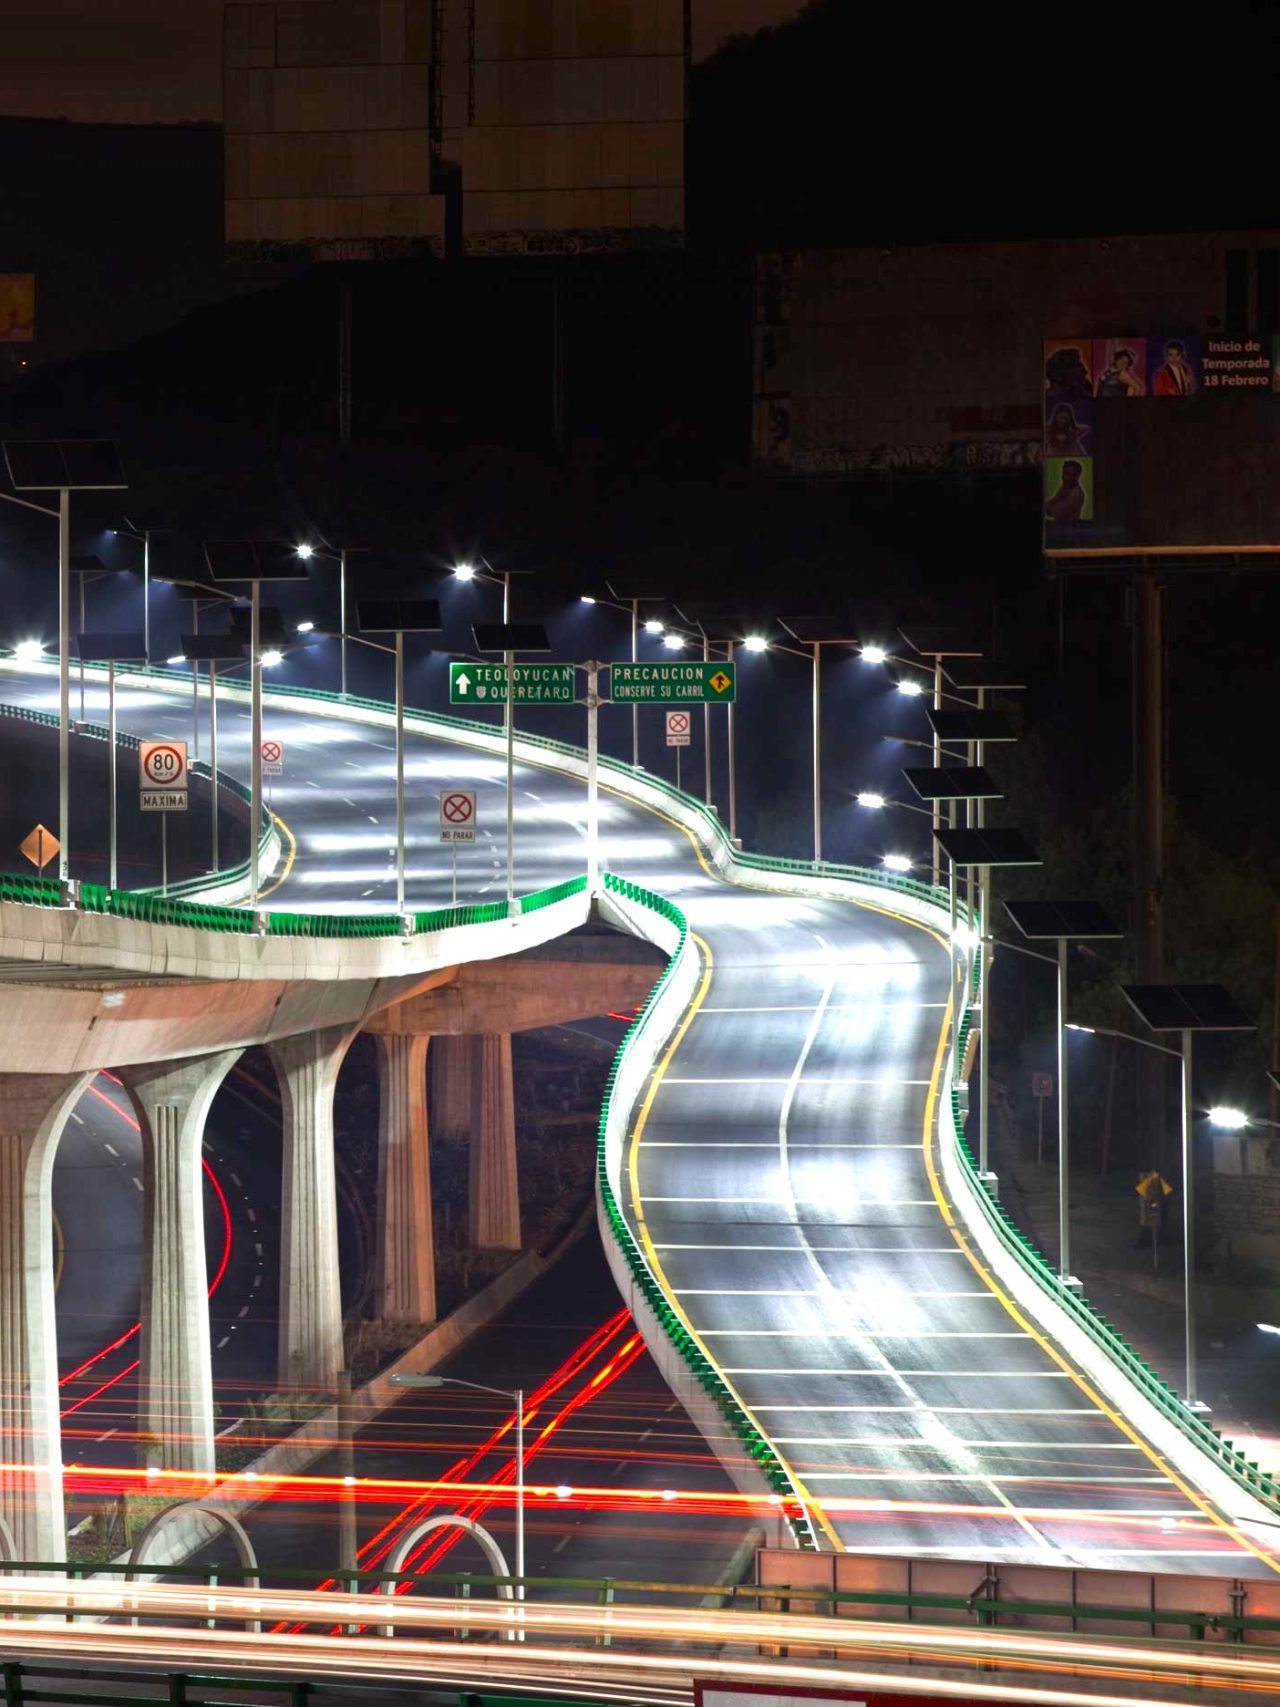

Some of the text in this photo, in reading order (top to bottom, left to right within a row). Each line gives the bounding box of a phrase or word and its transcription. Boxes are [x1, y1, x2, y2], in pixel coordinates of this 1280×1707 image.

[1208, 340, 1261, 353] Inicio de
[1201, 356, 1271, 371] Temporada
[1204, 374, 1270, 386] 18 Febrero
[476, 669, 570, 681] TEOLOYUCAN
[614, 667, 704, 680] PRECAUCION
[614, 685, 705, 698] CONSERVE SU CARRIL
[153, 753, 174, 771] 80
[143, 795, 185, 807] MAXIMA
[442, 831, 473, 840] NO PARAR
